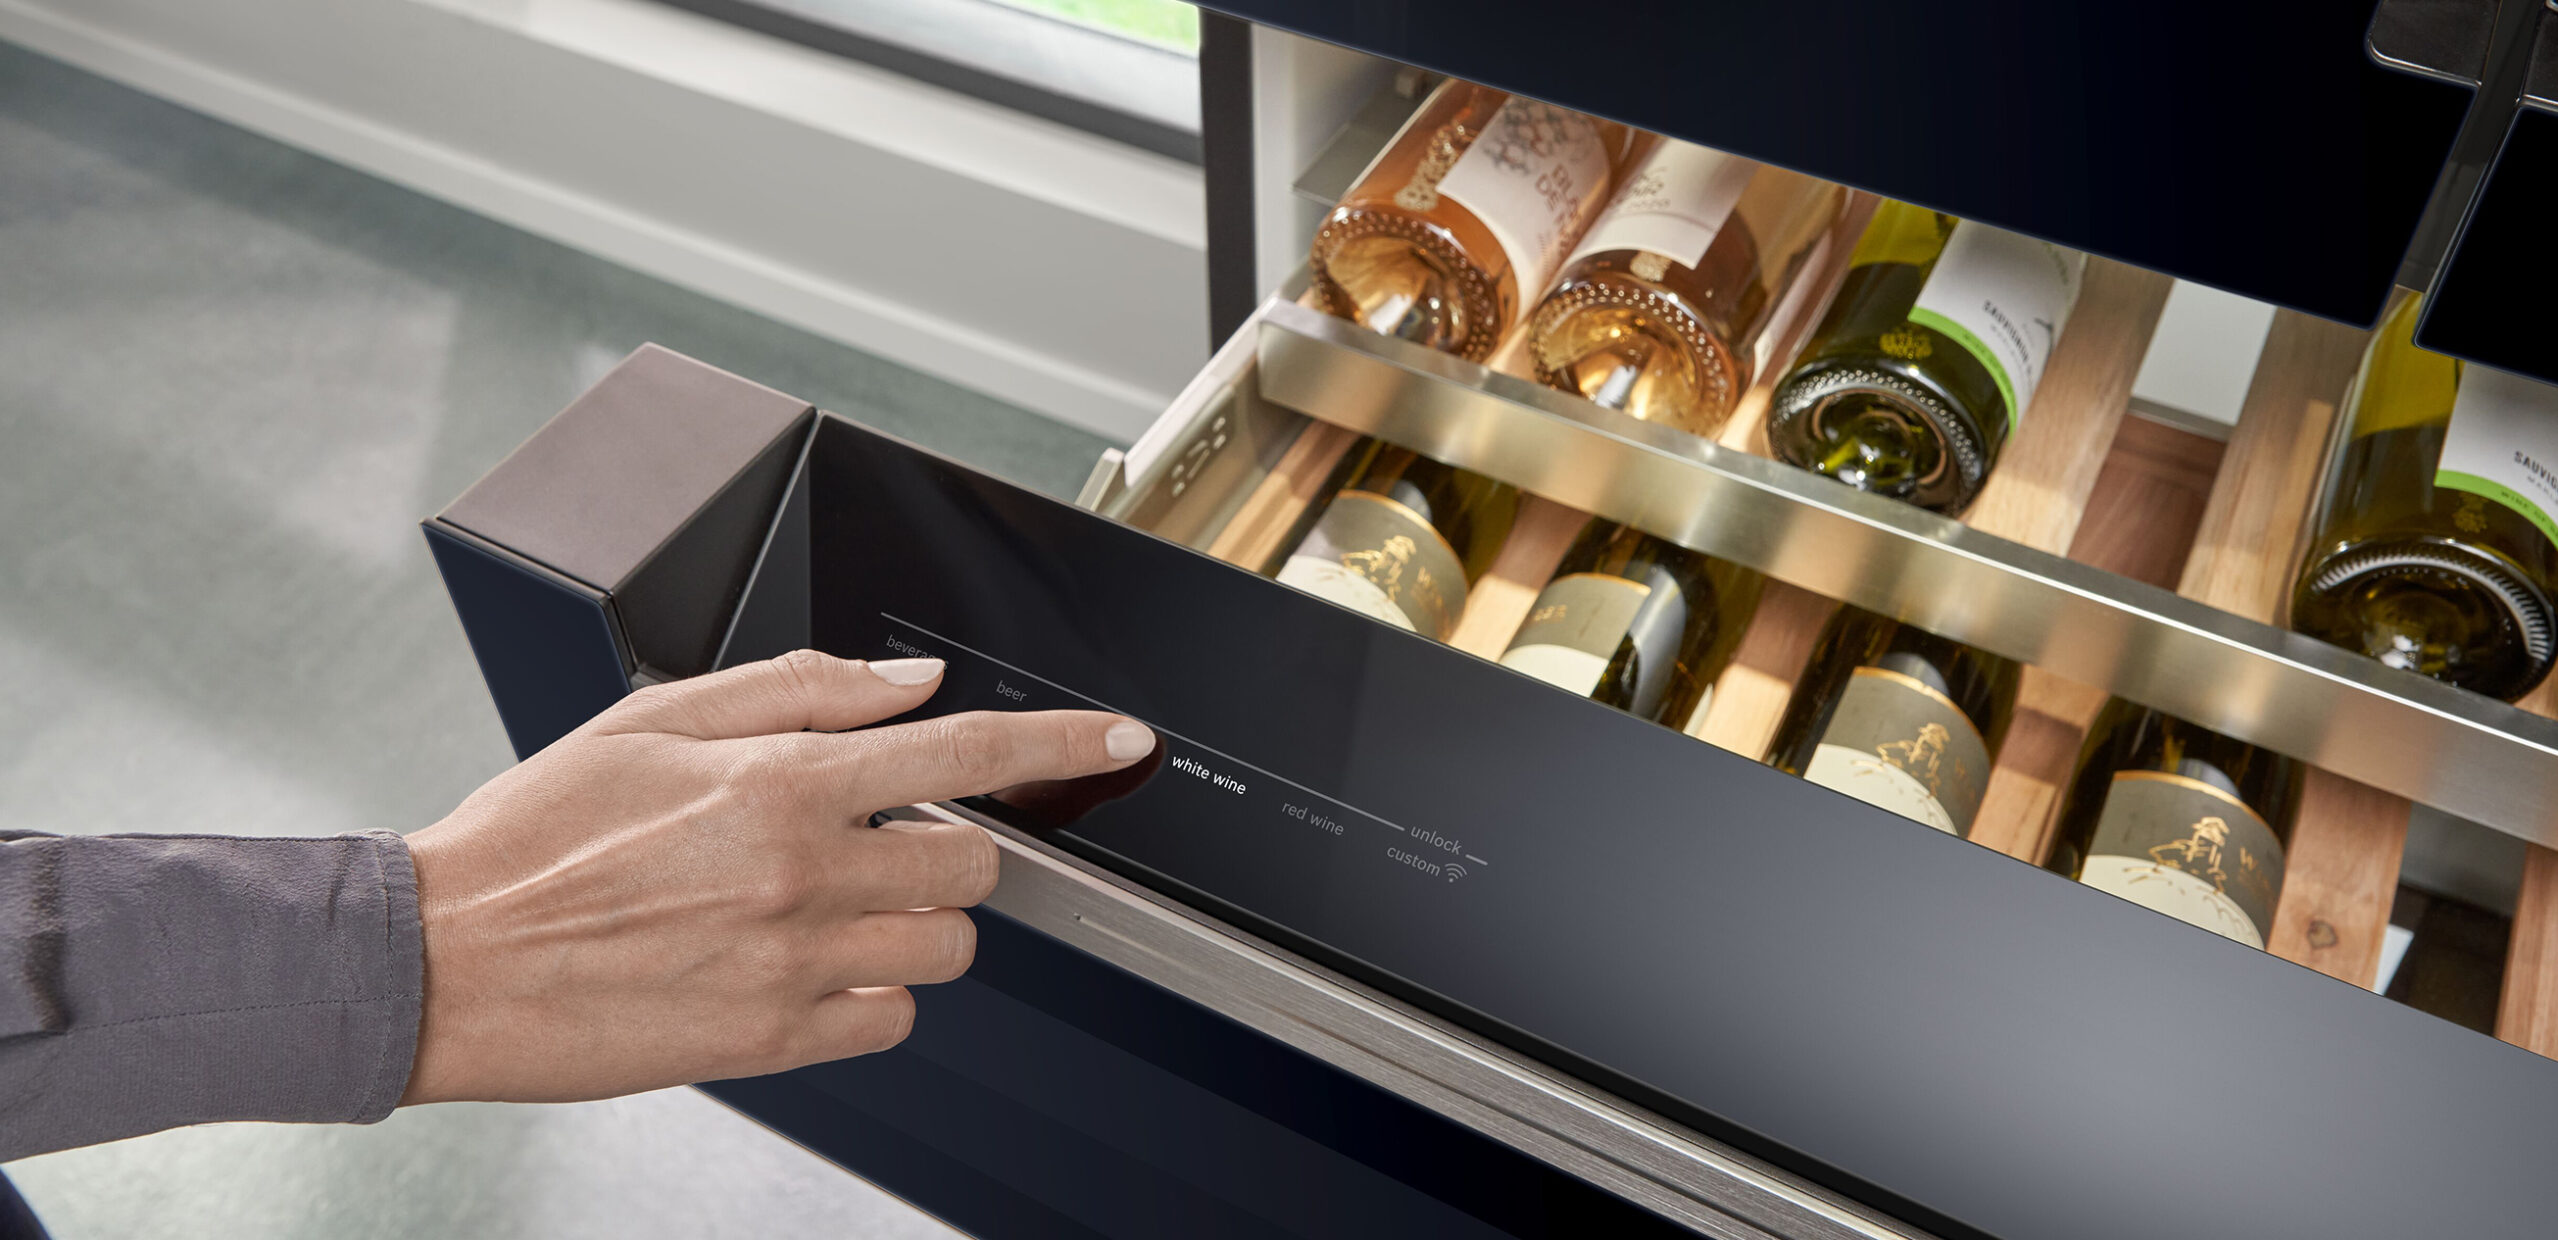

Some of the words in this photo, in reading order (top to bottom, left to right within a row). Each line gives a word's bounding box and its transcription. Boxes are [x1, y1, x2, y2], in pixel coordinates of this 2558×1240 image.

[886, 634, 949, 671] beveras
[996, 680, 1028, 702] beer
[1172, 756, 1210, 780] white
[1213, 773, 1247, 795] wine
[1281, 802, 1308, 820] red
[1310, 816, 1344, 836] wine
[1410, 826, 1462, 855] unlock
[1386, 847, 1441, 877] custom
